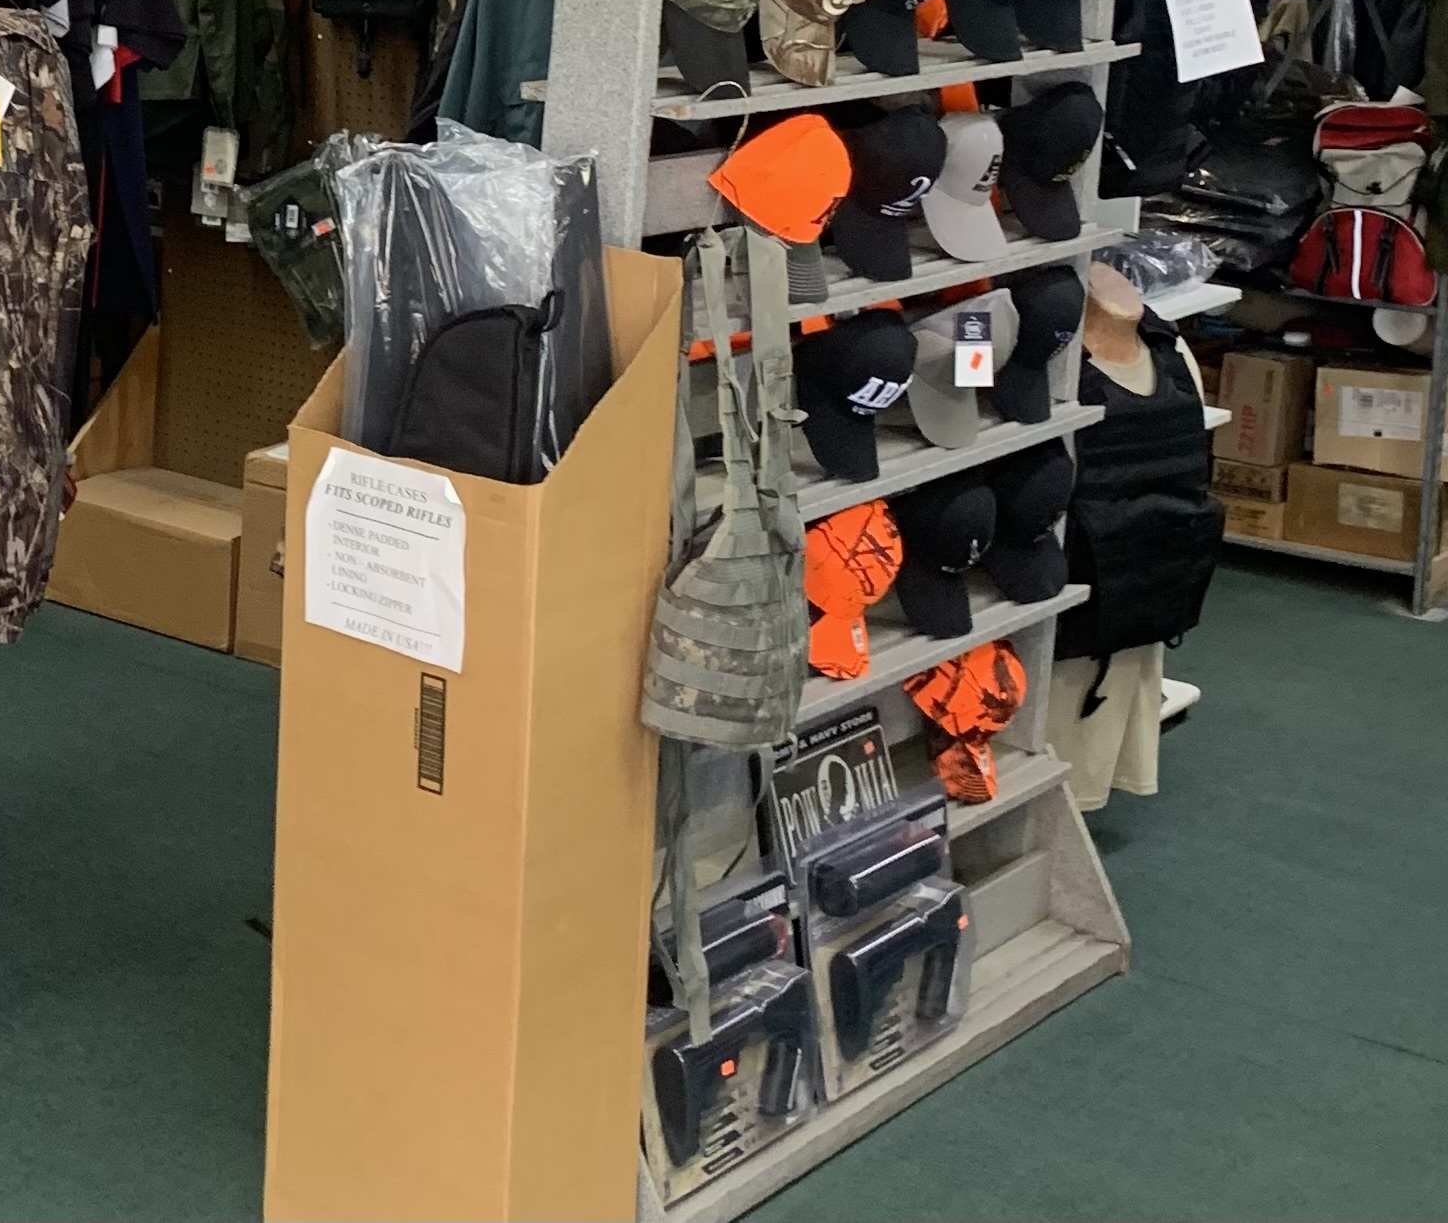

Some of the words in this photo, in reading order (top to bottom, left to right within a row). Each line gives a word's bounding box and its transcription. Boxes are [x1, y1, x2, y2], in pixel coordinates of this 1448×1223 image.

[350, 472, 385, 494] RIFLE
[388, 482, 429, 504] CASES
[325, 483, 352, 501] FITS
[355, 492, 403, 515] SCOPED
[406, 505, 453, 528] RIFLES
[332, 520, 366, 539] DENSE
[368, 527, 410, 551] PADDED
[332, 534, 380, 557] INTERIOR
[332, 565, 368, 584] LINING
[331, 581, 377, 603] LOCKING
[378, 594, 413, 615] ZIPPER
[344, 618, 379, 638] MADE
[381, 627, 394, 642] IN
[779, 786, 823, 859] POW
